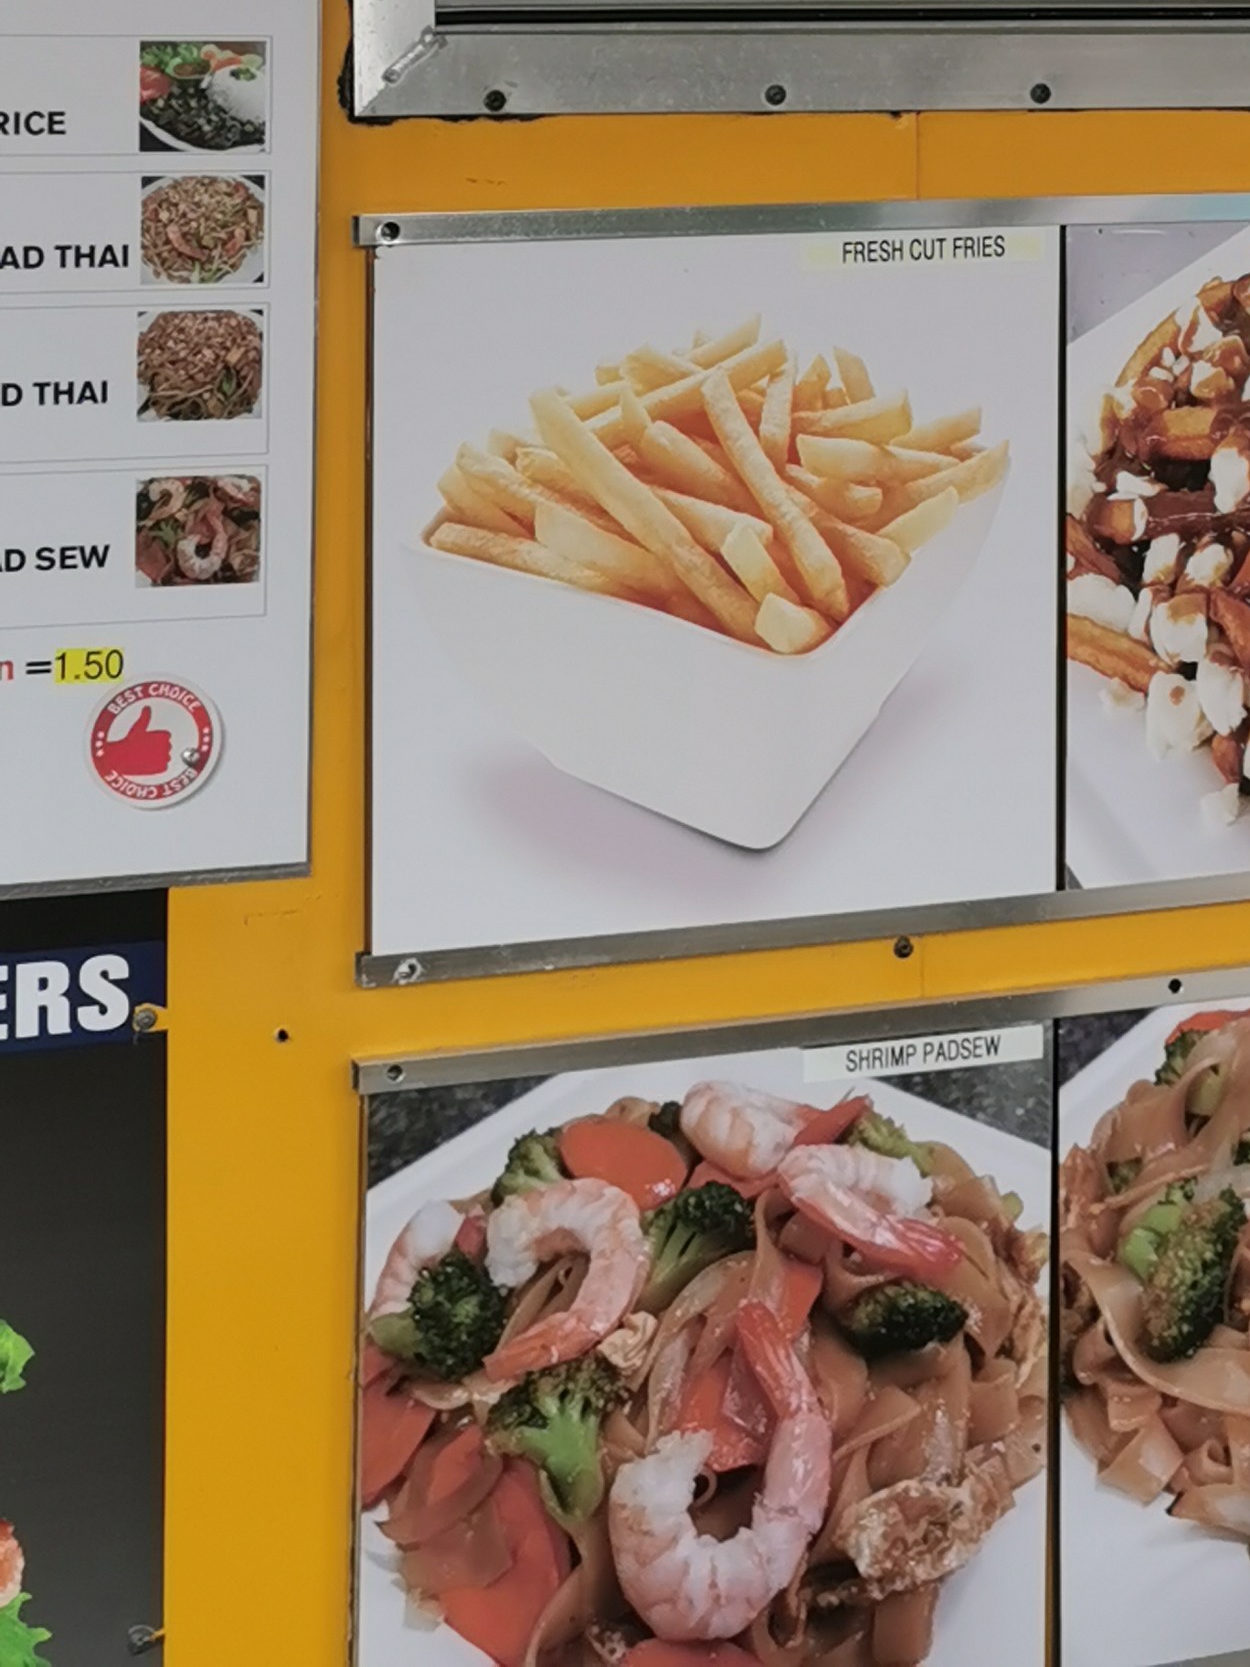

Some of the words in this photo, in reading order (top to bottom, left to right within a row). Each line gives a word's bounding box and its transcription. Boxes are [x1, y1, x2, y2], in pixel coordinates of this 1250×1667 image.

[0, 245, 44, 270] AD
[54, 244, 130, 269] THAI
[842, 239, 904, 264] FRESH
[909, 238, 947, 261] CUT
[953, 235, 1006, 259] FRIES
[32, 380, 108, 406] THAI
[0, 548, 26, 573] D
[35, 544, 110, 571] SEW
[107, 685, 144, 714] BEST
[148, 683, 201, 712] CHOICE
[105, 770, 157, 798] CHOICE
[0, 953, 129, 1041] RS
[846, 1044, 917, 1072] SHRIMP
[923, 1035, 1001, 1065] PADSEW
